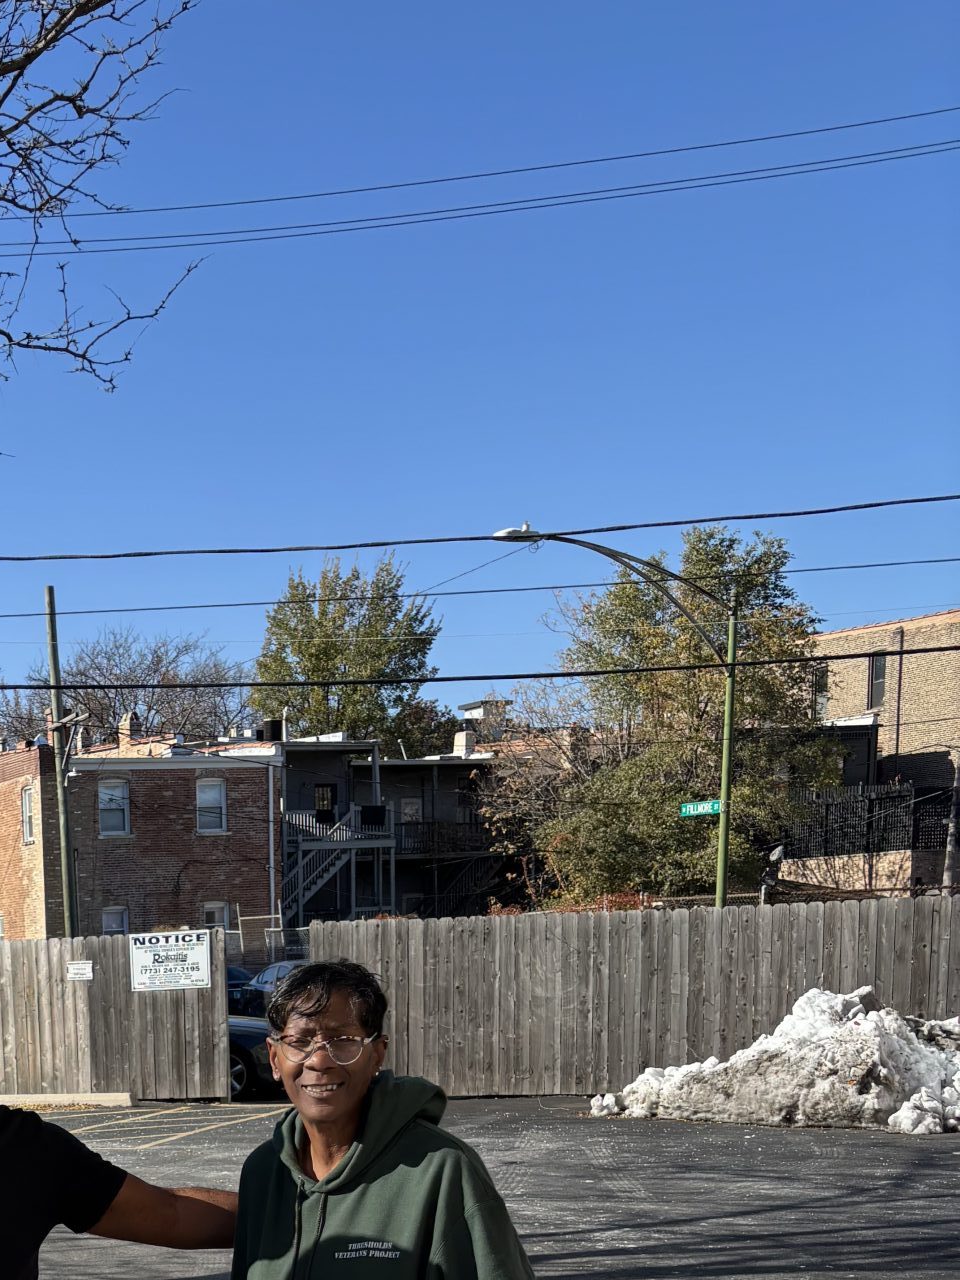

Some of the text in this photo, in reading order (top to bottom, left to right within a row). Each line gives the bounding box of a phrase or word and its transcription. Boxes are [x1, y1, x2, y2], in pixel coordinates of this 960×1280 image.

[687, 803, 713, 814] FILLMORE
[134, 934, 205, 946] NOTICE
[348, 1241, 393, 1250] THRESHOLDS
[335, 1250, 400, 1259] VETERANS PROJECT
